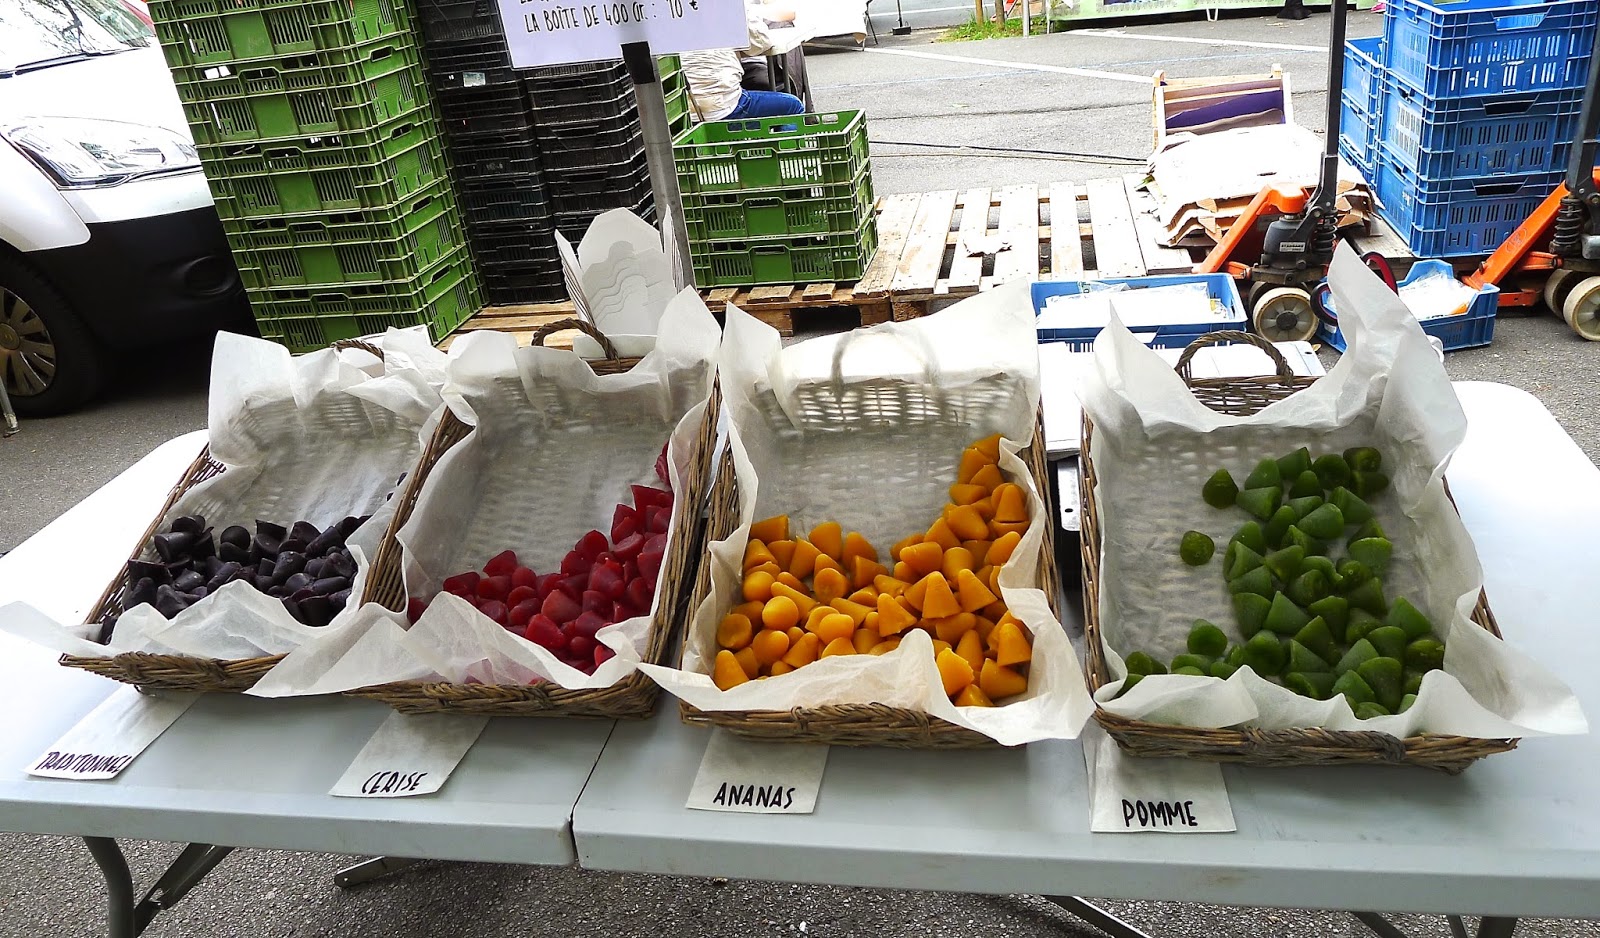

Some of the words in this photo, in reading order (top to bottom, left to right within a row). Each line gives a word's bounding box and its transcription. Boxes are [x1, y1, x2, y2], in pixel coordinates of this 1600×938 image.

[524, 13, 541, 33] LA
[543, 5, 580, 32] BOÎTE
[583, 5, 600, 28] DE
[603, 3, 629, 26] 400
[665, 0, 683, 19] 10
[34, 751, 133, 774] TRADITIONNEL
[361, 771, 428, 795] CERISE
[712, 782, 796, 809] ANANAS
[1121, 799, 1199, 827] POMME
